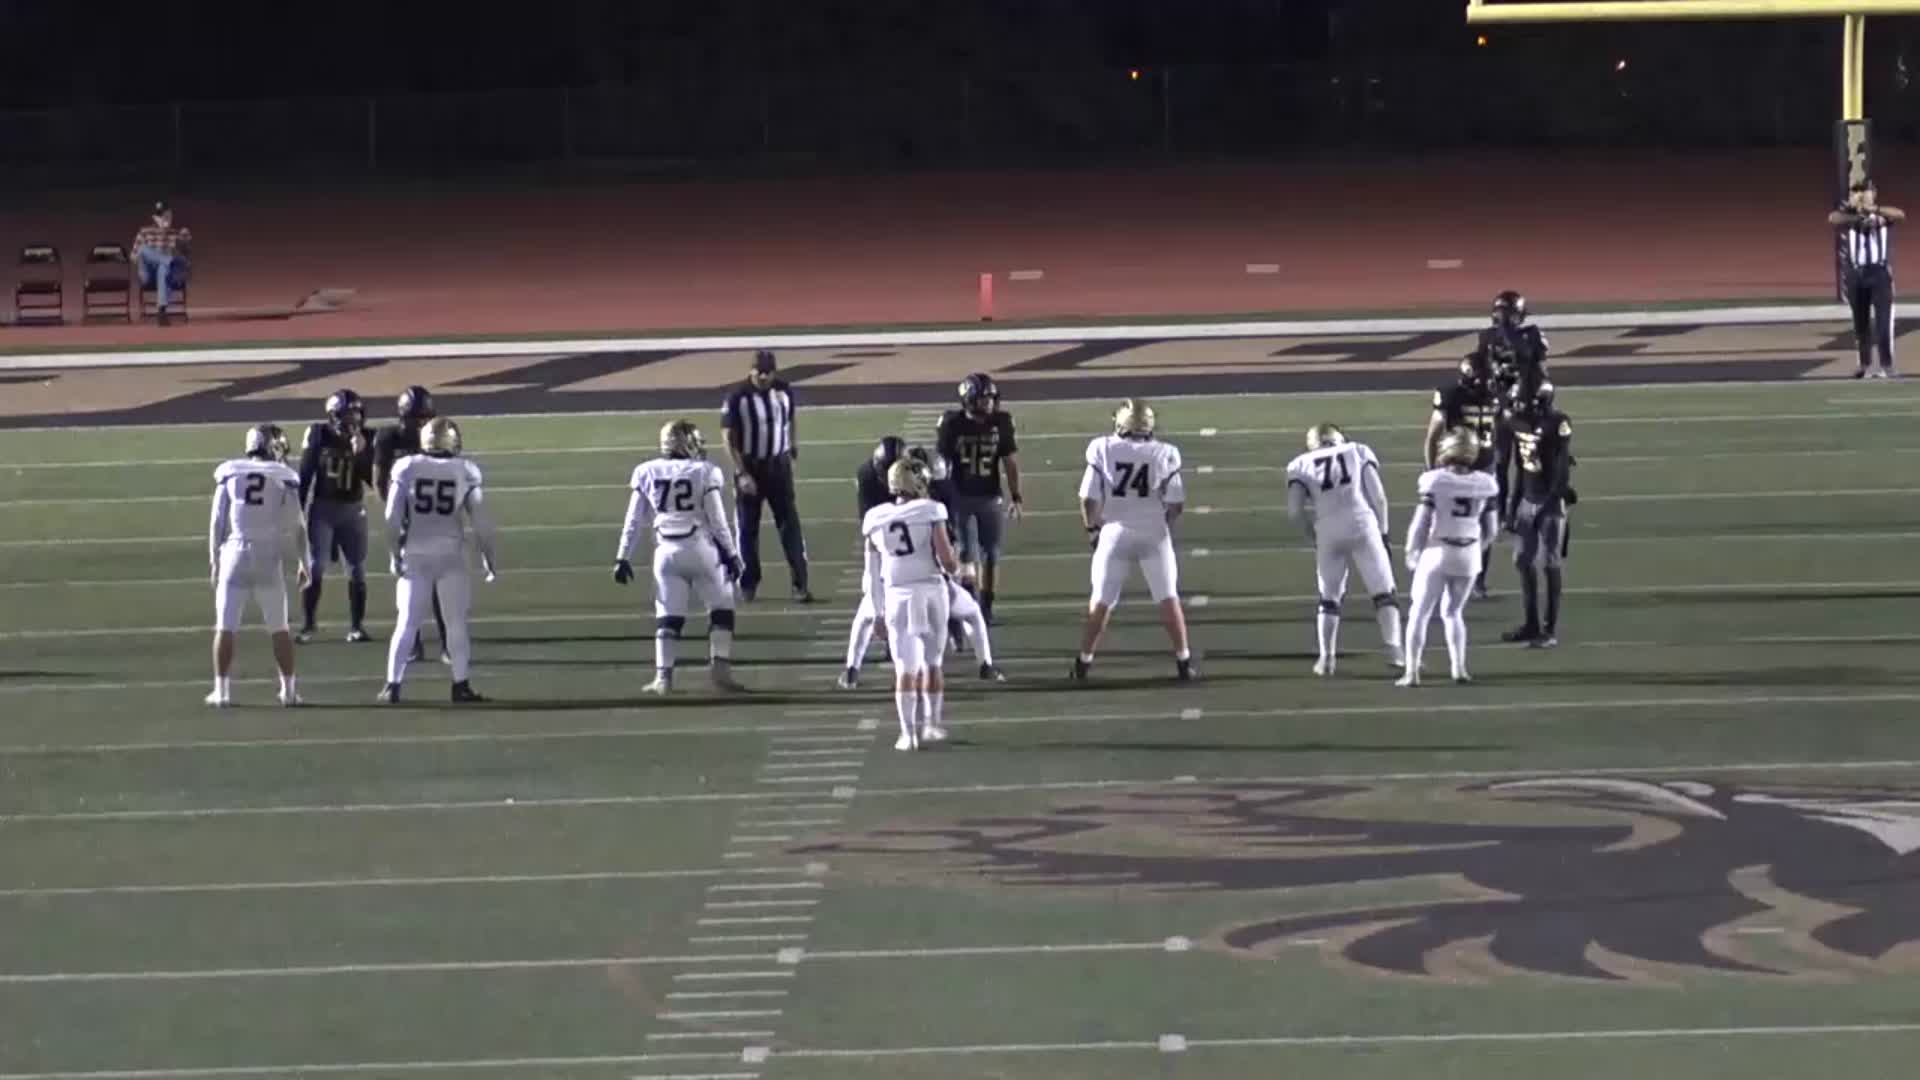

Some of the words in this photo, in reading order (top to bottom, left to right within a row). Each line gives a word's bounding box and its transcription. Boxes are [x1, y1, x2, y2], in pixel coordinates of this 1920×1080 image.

[326, 456, 353, 490] 41
[959, 443, 998, 476] 42
[1313, 453, 1351, 491] 71
[245, 473, 265, 505] 2
[654, 479, 694, 512] 72
[1112, 462, 1149, 497] 74
[415, 479, 455, 515] 55
[889, 521, 914, 556] 3
